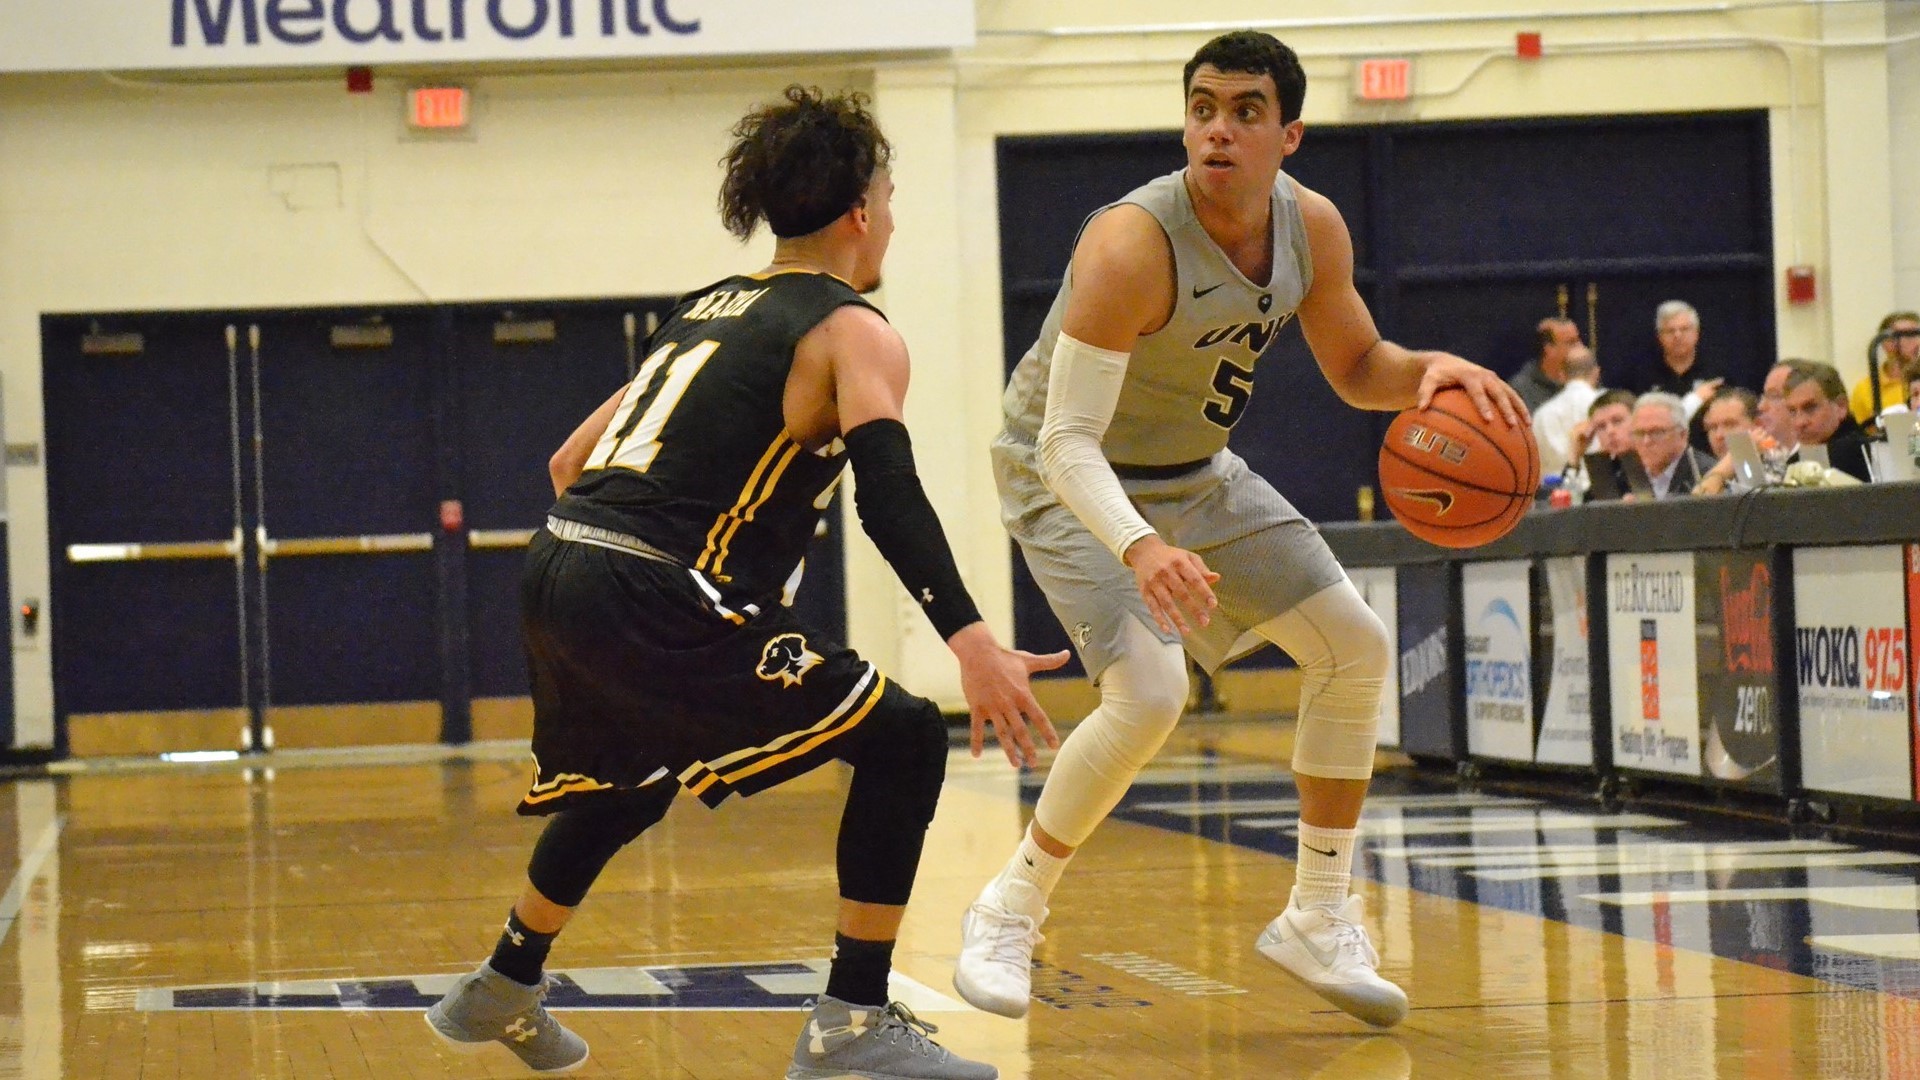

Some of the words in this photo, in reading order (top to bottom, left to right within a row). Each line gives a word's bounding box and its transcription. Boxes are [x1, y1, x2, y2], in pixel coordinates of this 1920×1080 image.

[582, 339, 721, 474] 11
[1200, 355, 1254, 431] 5
[1797, 625, 1860, 689] WOKQ
